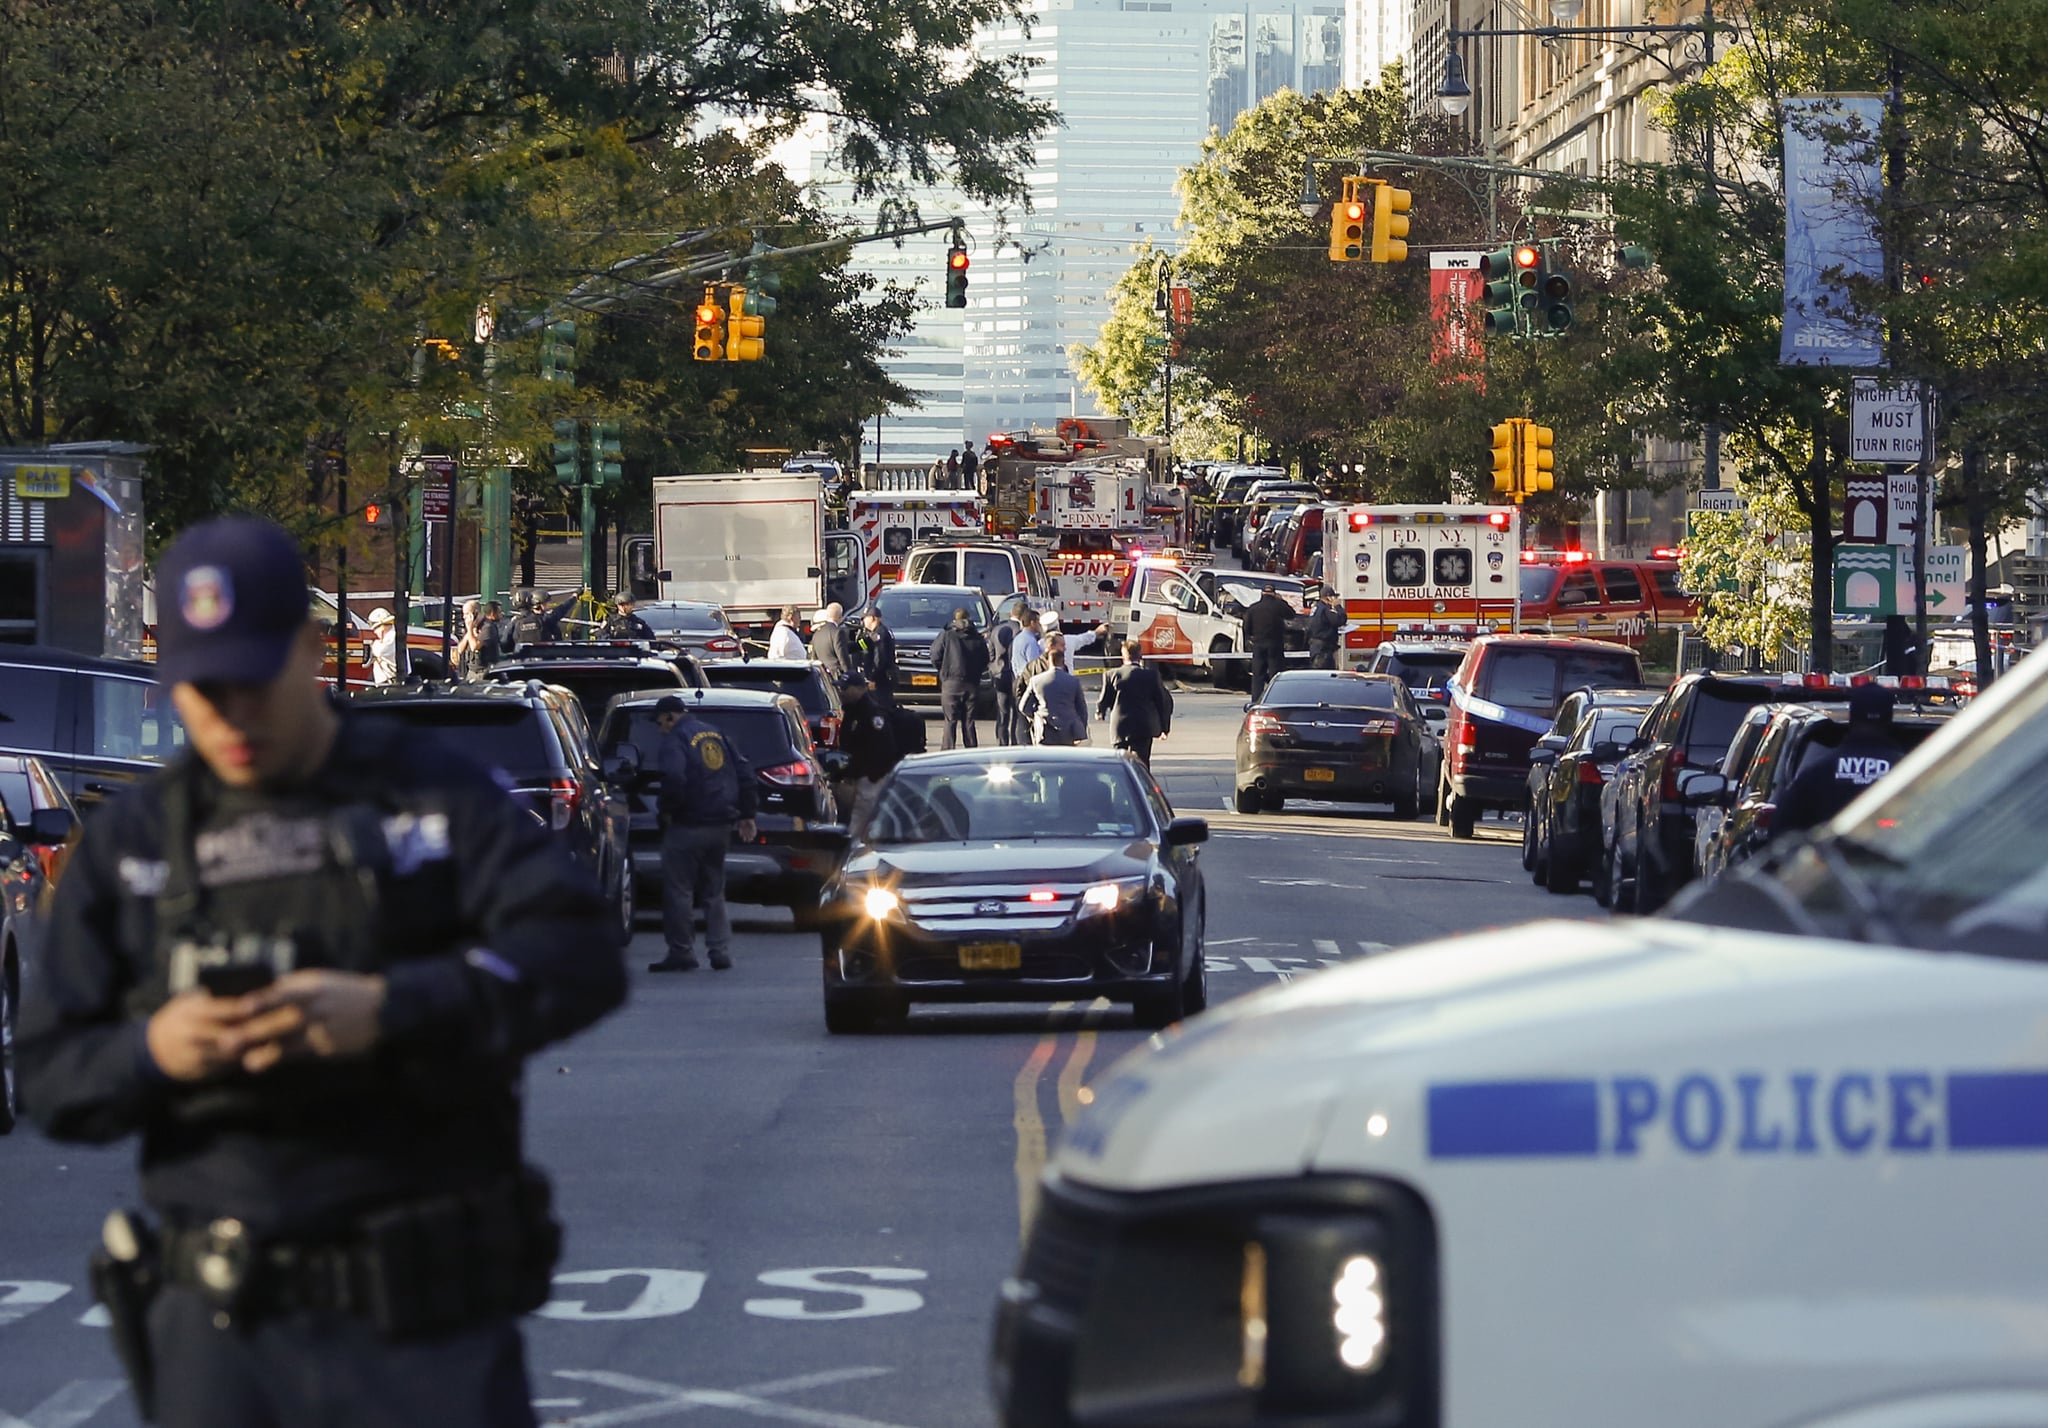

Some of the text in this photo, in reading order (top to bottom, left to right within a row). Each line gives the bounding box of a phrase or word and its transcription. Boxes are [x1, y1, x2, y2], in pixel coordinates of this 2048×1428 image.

[1856, 389, 1922, 402] RIGHT LAN
[1872, 412, 1913, 428] MUST
[1855, 438, 1923, 451] TURN RIGH
[26, 471, 58, 481] PLAY
[26, 483, 61, 493] HERE
[1890, 481, 1930, 493] Hollad
[1041, 487, 1049, 511] 1
[1125, 487, 1135, 511] 1
[1703, 499, 1733, 510] RIGHT
[1893, 498, 1918, 511] Tunn
[1393, 529, 1467, 542] F.D. N.Y.
[1486, 532, 1504, 541] 403
[1902, 552, 1960, 565] Lcoln
[1063, 562, 1112, 576] FDNY
[1905, 570, 1957, 583] Tnnel
[1387, 587, 1470, 598] AMBULANCE
[1615, 617, 1650, 636] FDNY
[1838, 757, 1890, 776] NYPD
[1612, 1073, 1934, 1157] POLICE
